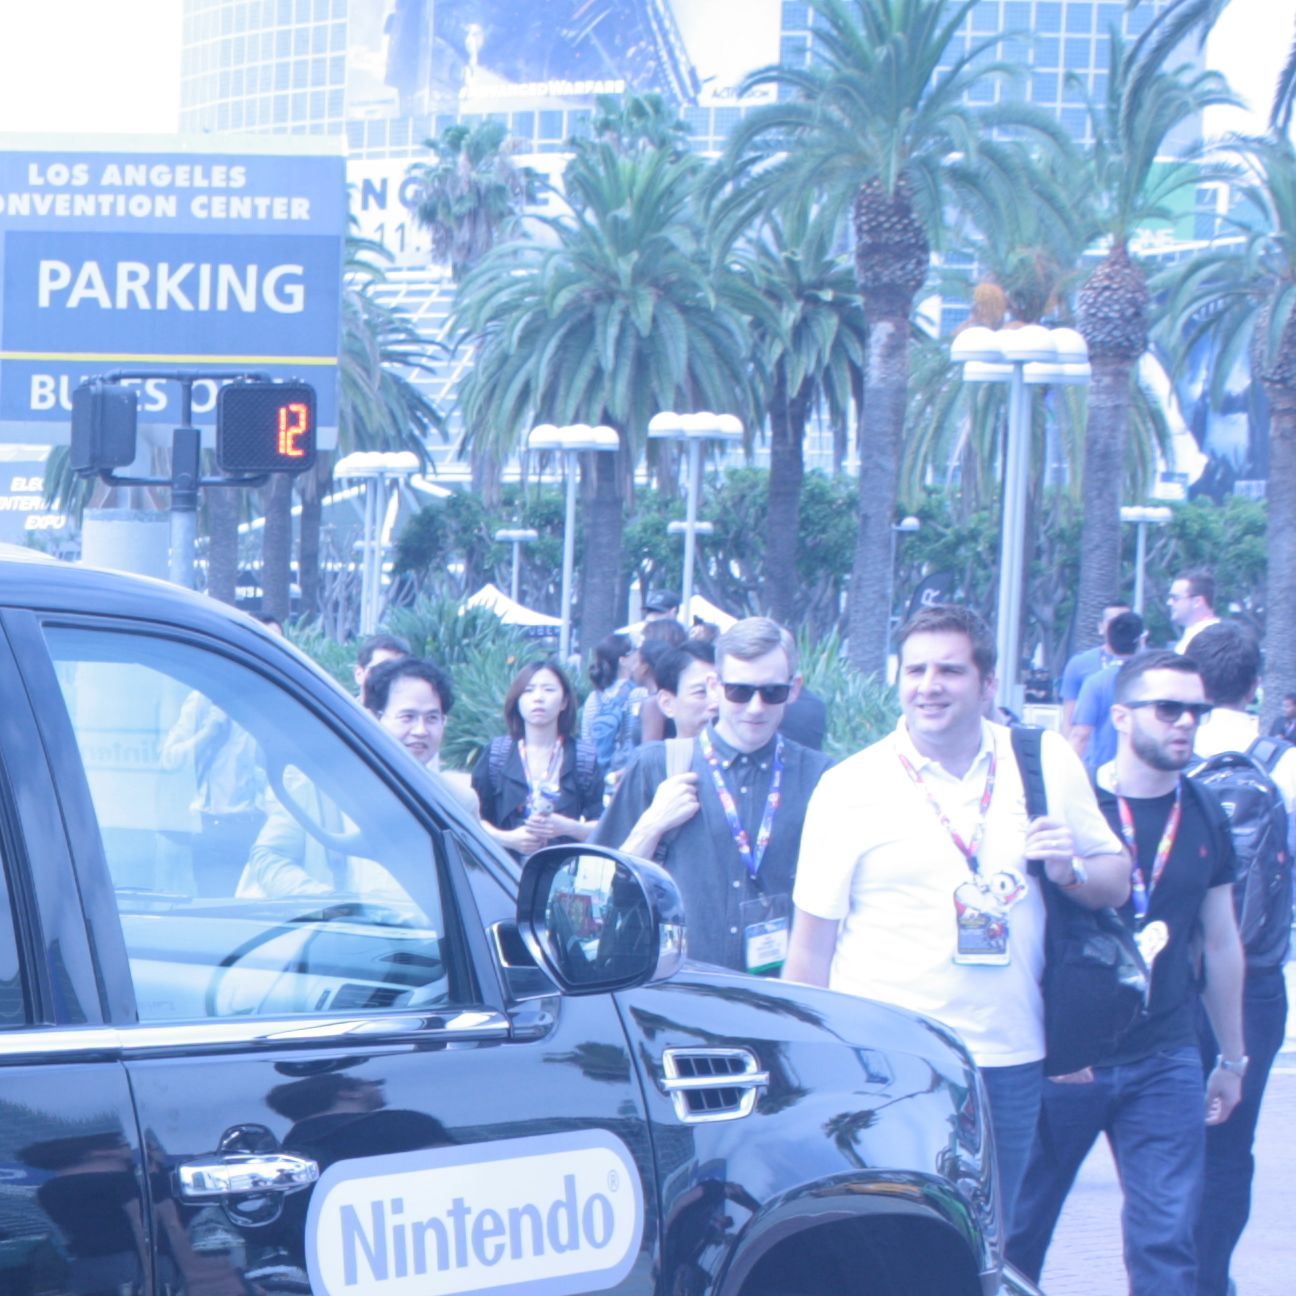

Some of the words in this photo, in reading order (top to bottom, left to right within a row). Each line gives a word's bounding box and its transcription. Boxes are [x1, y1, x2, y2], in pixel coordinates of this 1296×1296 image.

[28, 162, 90, 187] LOS
[100, 163, 247, 189] ANGELES
[190, 195, 311, 221] CENTER
[37, 258, 306, 314] PARKING
[276, 402, 309, 457] 12
